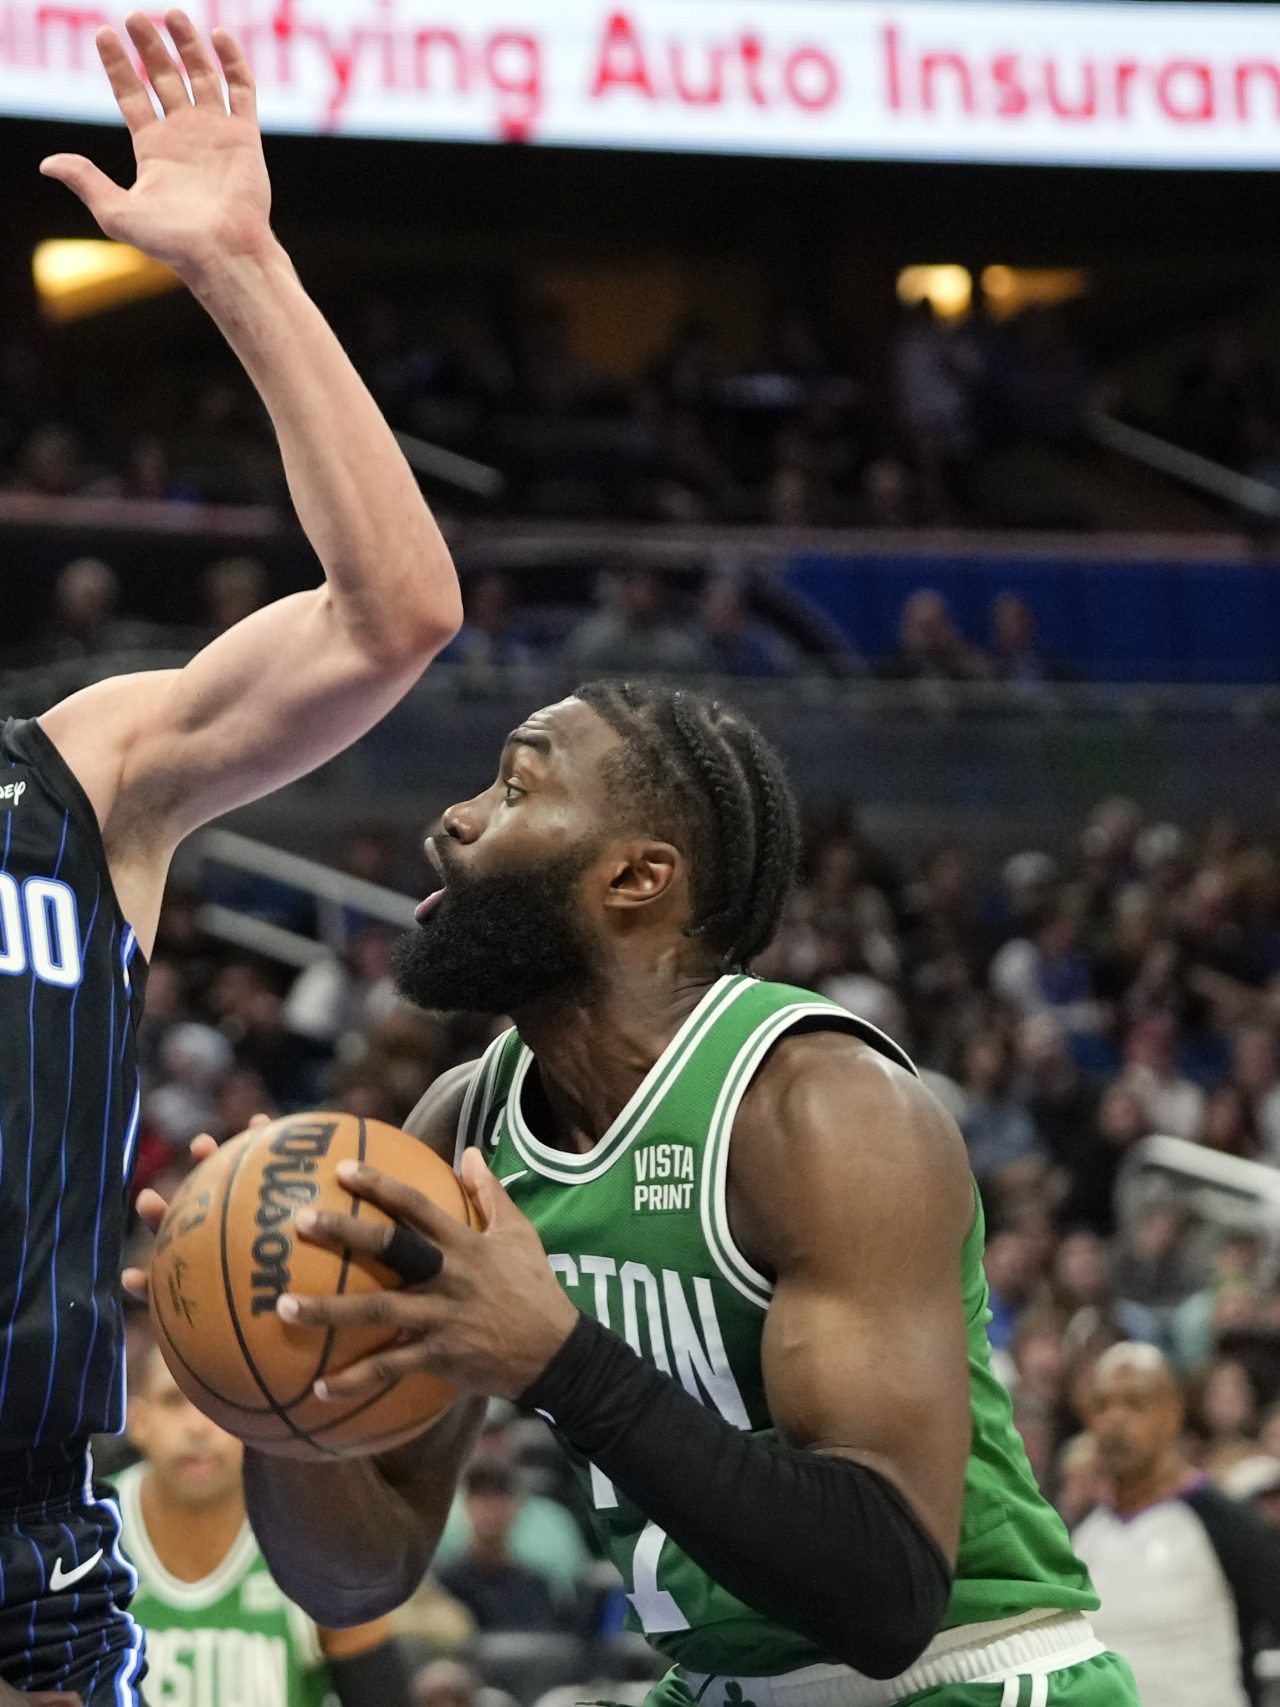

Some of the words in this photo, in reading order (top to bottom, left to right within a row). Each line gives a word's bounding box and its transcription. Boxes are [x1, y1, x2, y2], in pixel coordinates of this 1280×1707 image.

[591, 12, 839, 112] Auto
[880, 22, 1280, 122] Insuran
[634, 1144, 694, 1183] VISTA
[634, 1183, 694, 1211] PRINT
